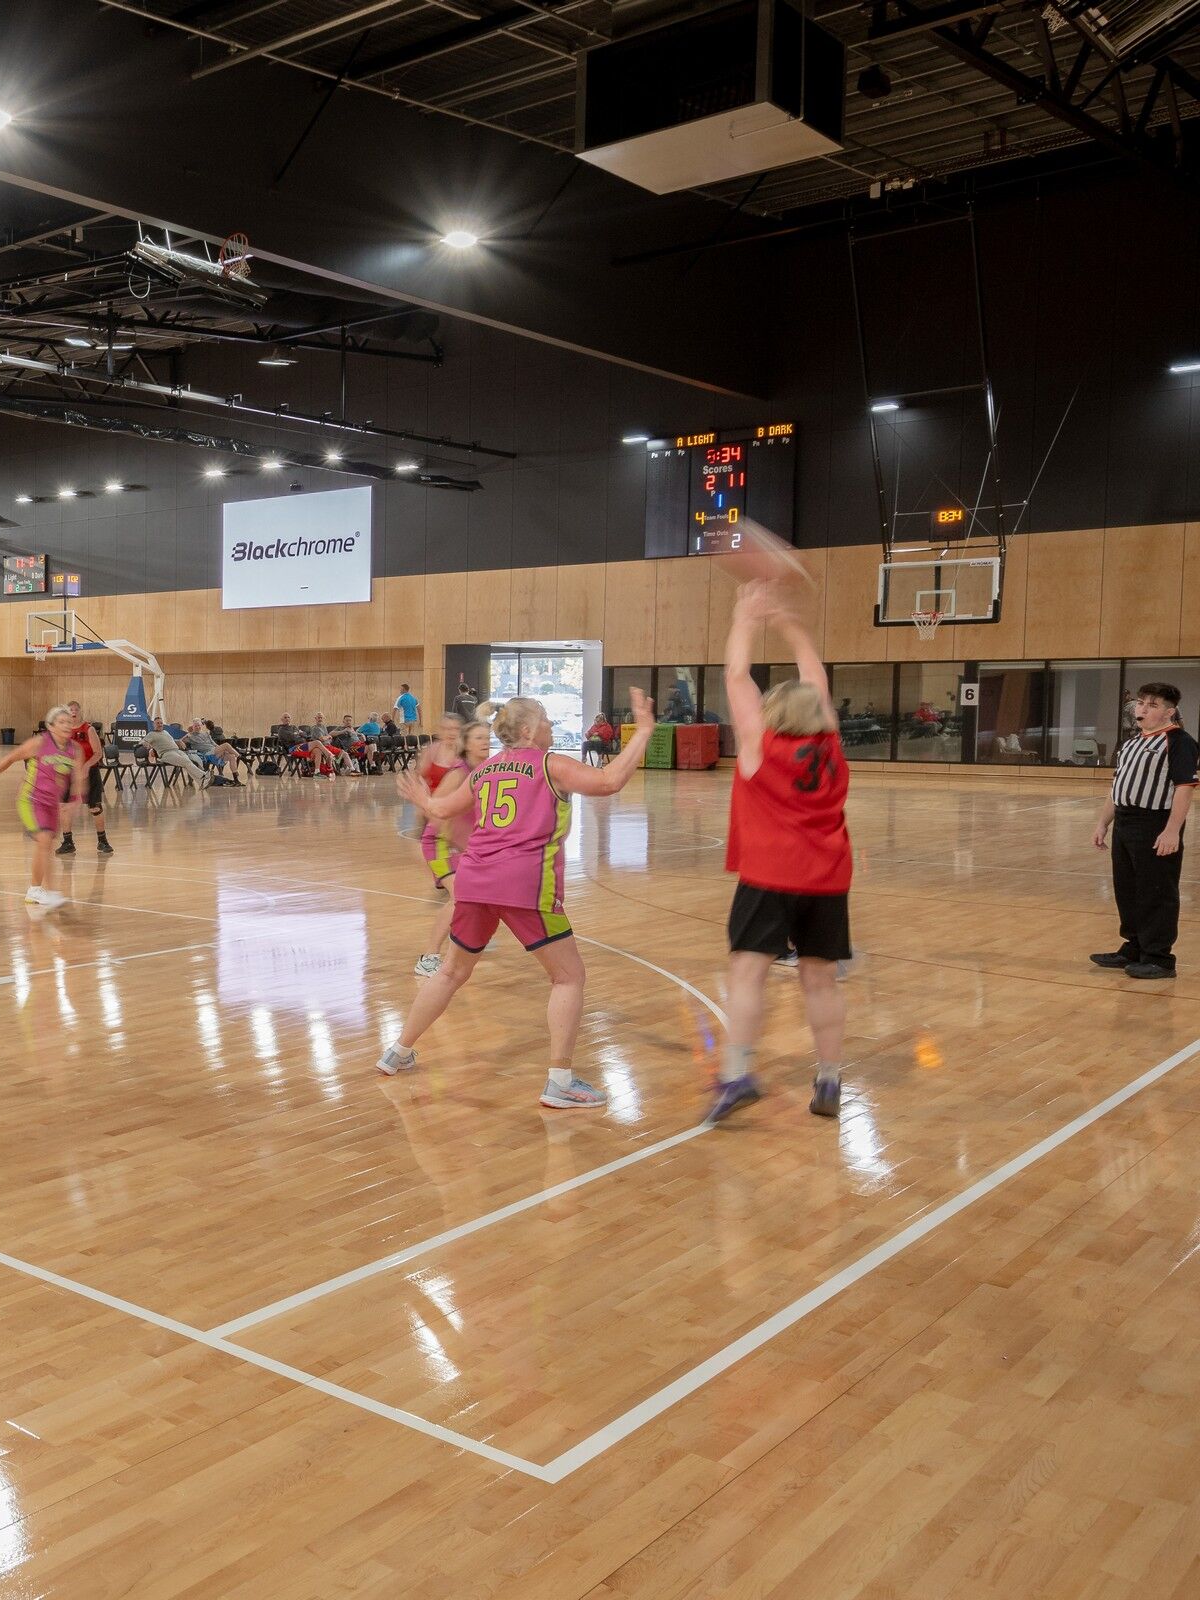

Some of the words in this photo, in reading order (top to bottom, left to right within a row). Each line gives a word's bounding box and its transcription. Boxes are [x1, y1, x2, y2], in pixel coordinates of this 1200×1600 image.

[757, 427, 765, 438] B
[769, 423, 793, 436] DARK
[677, 437, 684, 448] A
[687, 433, 715, 446] LIGHT
[703, 465, 732, 475] Scores
[705, 474, 716, 490] 2
[729, 472, 744, 487] 11
[718, 493, 723, 508] 1
[695, 511, 705, 525] 4
[728, 508, 738, 524] 0
[731, 533, 741, 549] 2
[231, 536, 355, 562] Blackchrome
[965, 688, 975, 701] 6
[117, 729, 129, 737] BIG
[129, 729, 147, 737] SHED
[472, 761, 535, 786] AUSTRALIA
[478, 778, 519, 830] 15
